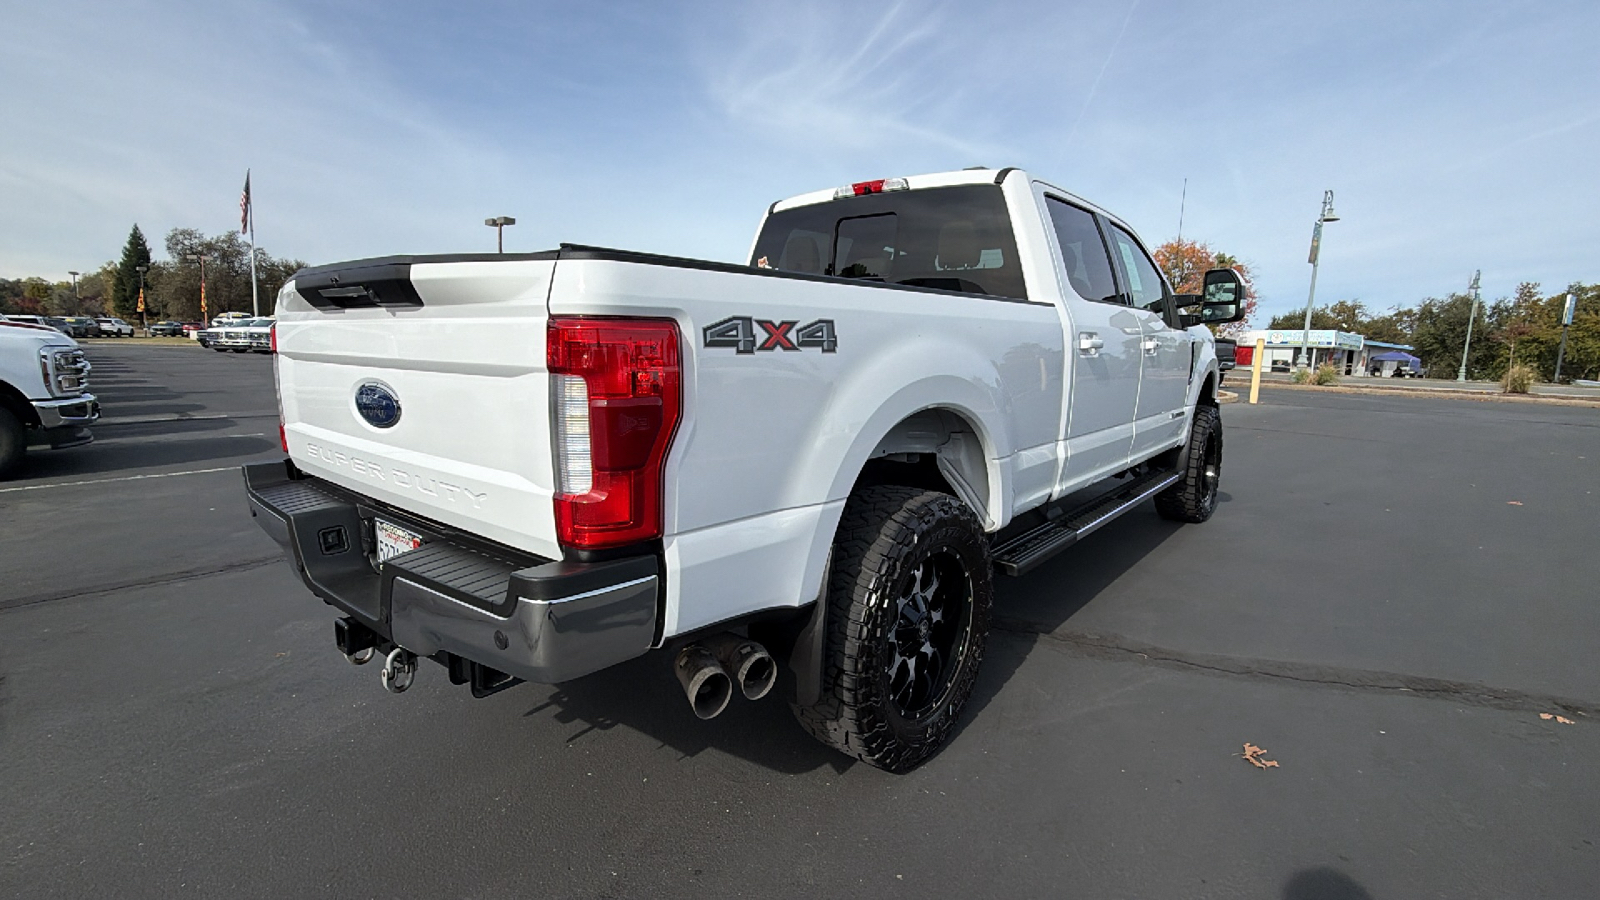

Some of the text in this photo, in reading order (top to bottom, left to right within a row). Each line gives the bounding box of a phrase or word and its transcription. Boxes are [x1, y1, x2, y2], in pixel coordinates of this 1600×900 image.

[703, 315, 838, 355] 4X4
[306, 442, 487, 509] SUPER DUTY
